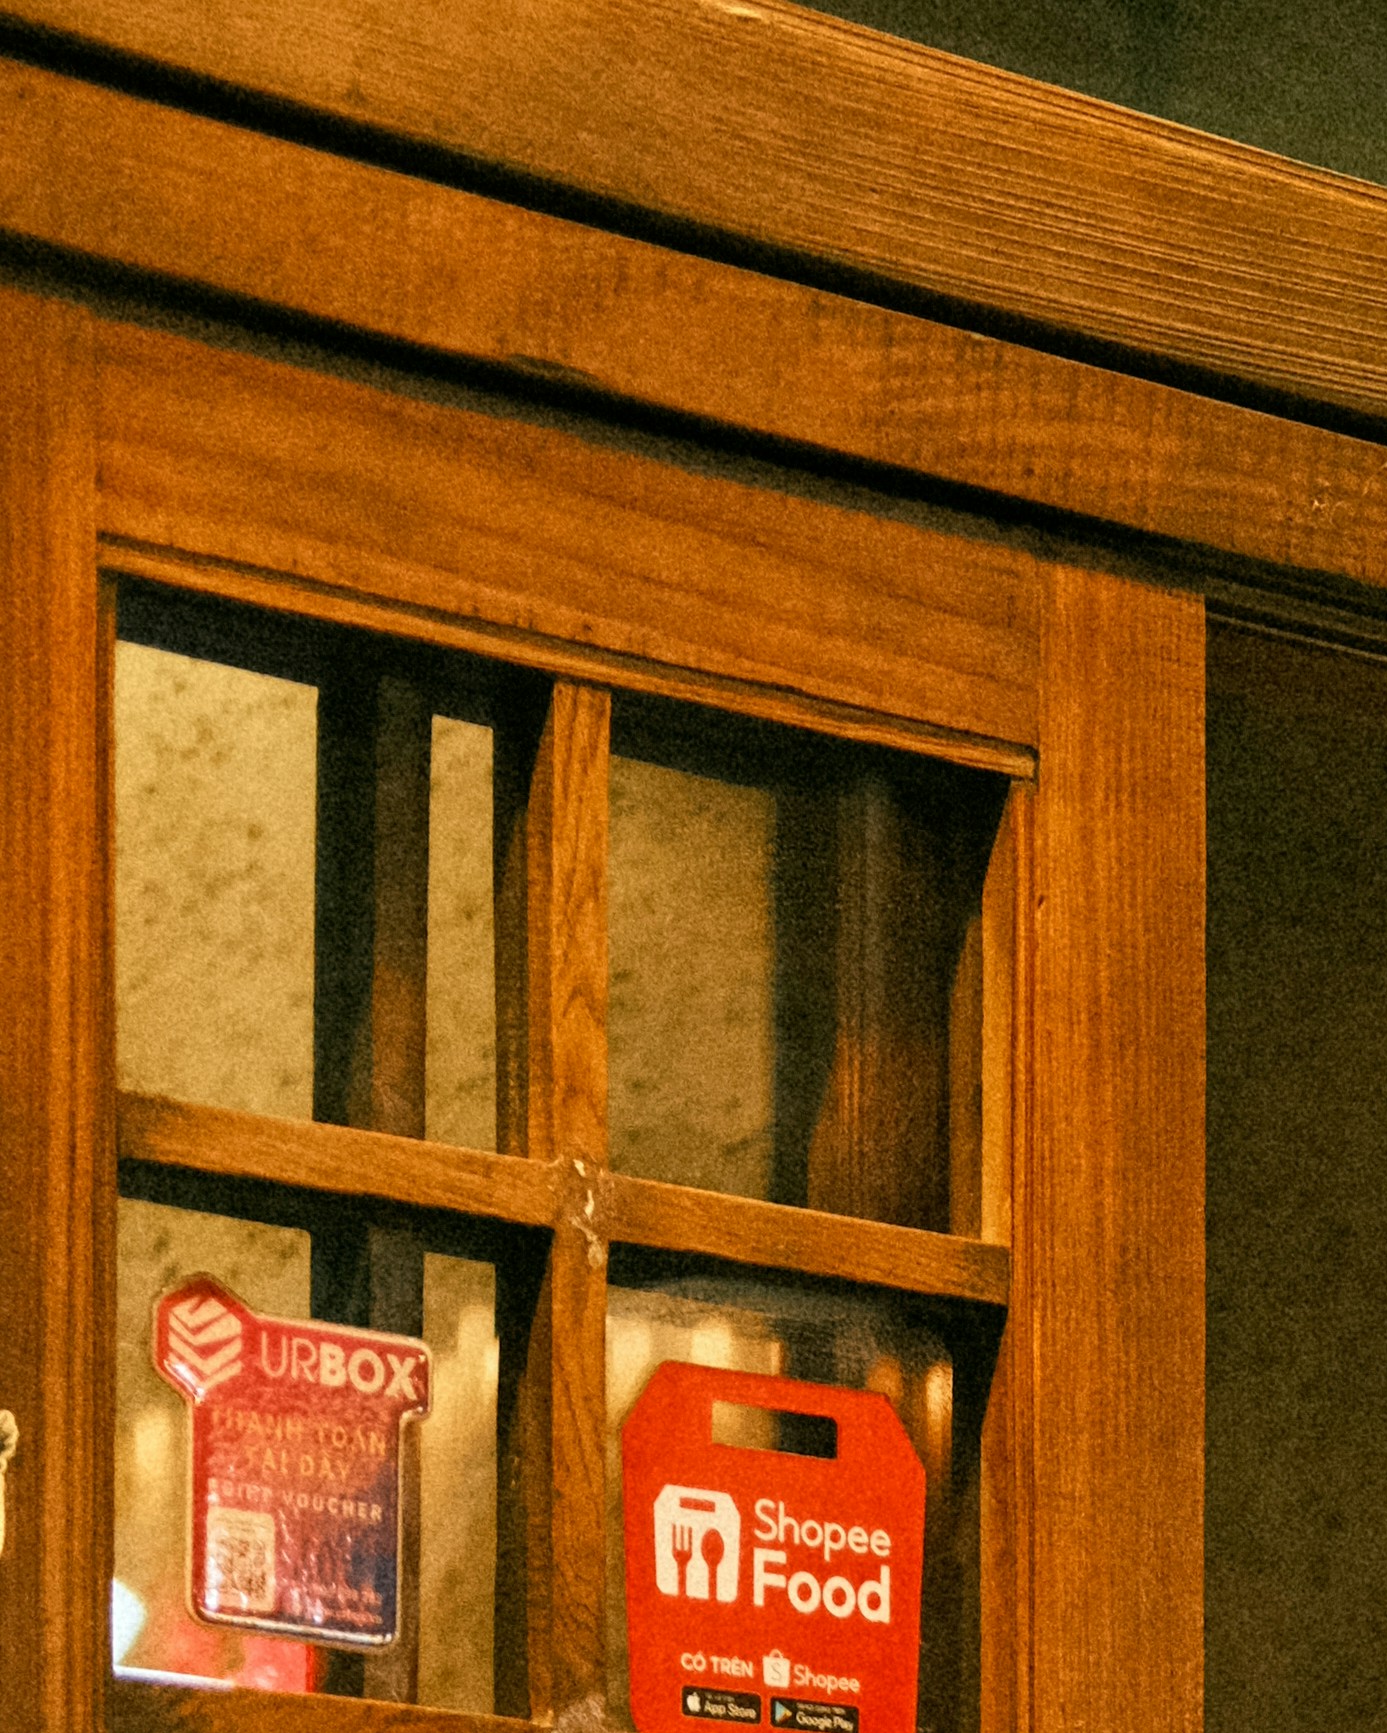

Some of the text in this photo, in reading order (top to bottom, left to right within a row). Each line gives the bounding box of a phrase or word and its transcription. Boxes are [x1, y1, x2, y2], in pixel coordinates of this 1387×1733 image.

[261, 1331, 418, 1400] URBOX
[753, 1498, 892, 1562] Shopee
[753, 1547, 891, 1624] Food
[709, 1655, 754, 1679] TRÊN
[793, 1663, 861, 1696] Shopee
[703, 1700, 757, 1720] App Store
[795, 1711, 854, 1733] Google Play
